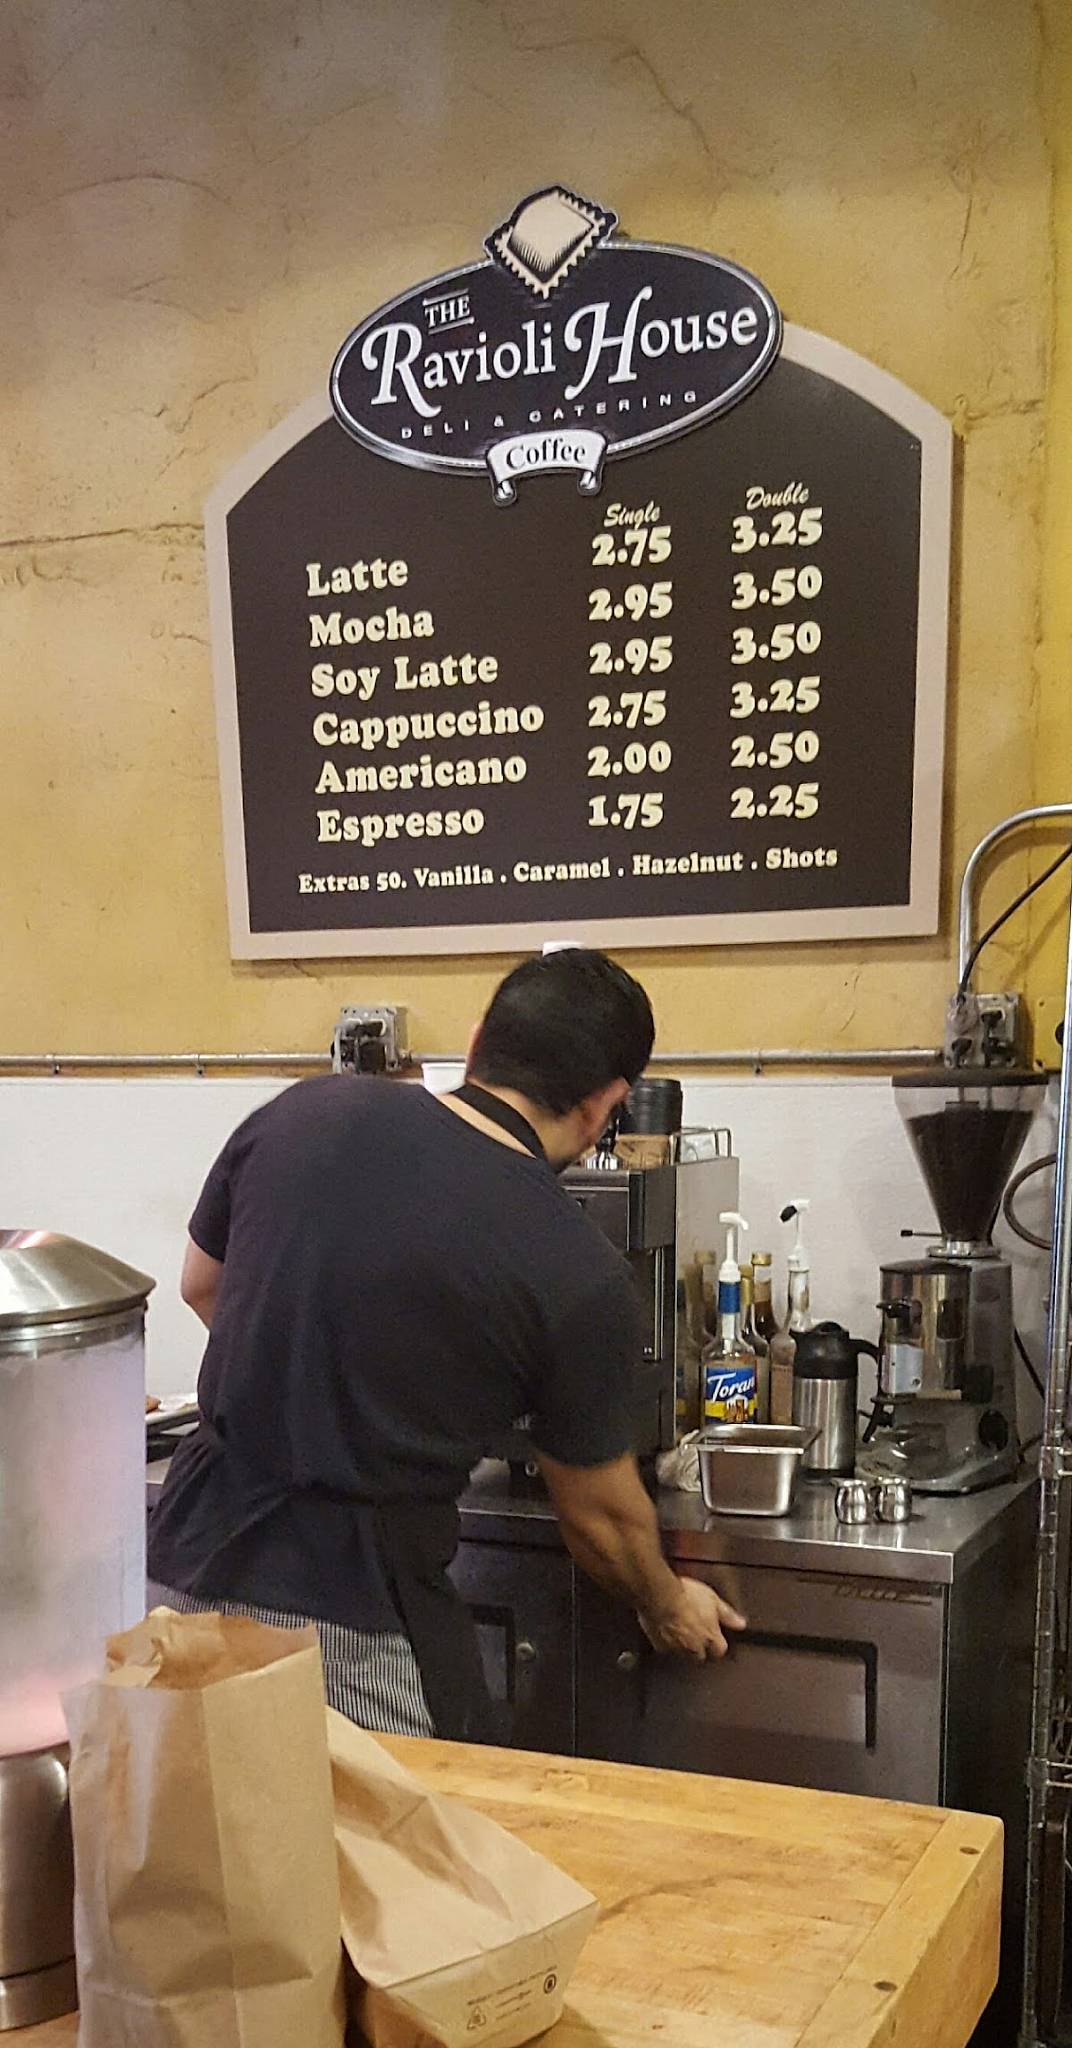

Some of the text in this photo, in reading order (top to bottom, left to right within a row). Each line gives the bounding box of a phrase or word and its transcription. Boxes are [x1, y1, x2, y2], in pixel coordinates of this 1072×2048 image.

[425, 296, 470, 328] THE
[361, 285, 758, 418] Ravioli House
[401, 391, 697, 439] DELI & CATERING
[505, 437, 586, 470] Coffee
[604, 482, 809, 529] Single Double
[306, 507, 823, 596] Latte 2.75 3.25
[309, 566, 822, 647] Mocha 2.95 3.50
[312, 621, 821, 700] Soy Latte 2.95 3.50
[313, 676, 820, 750] Cappuccino 2.75 3.25
[315, 731, 819, 793] Americano 2.00 2.50
[317, 783, 819, 846] Espresso 1.75 2.25
[299, 874, 369, 893] Extras
[414, 865, 493, 887] Vanilla
[514, 857, 610, 882] Caramel
[633, 852, 743, 875] Hazelnut
[766, 847, 837, 869] Shots
